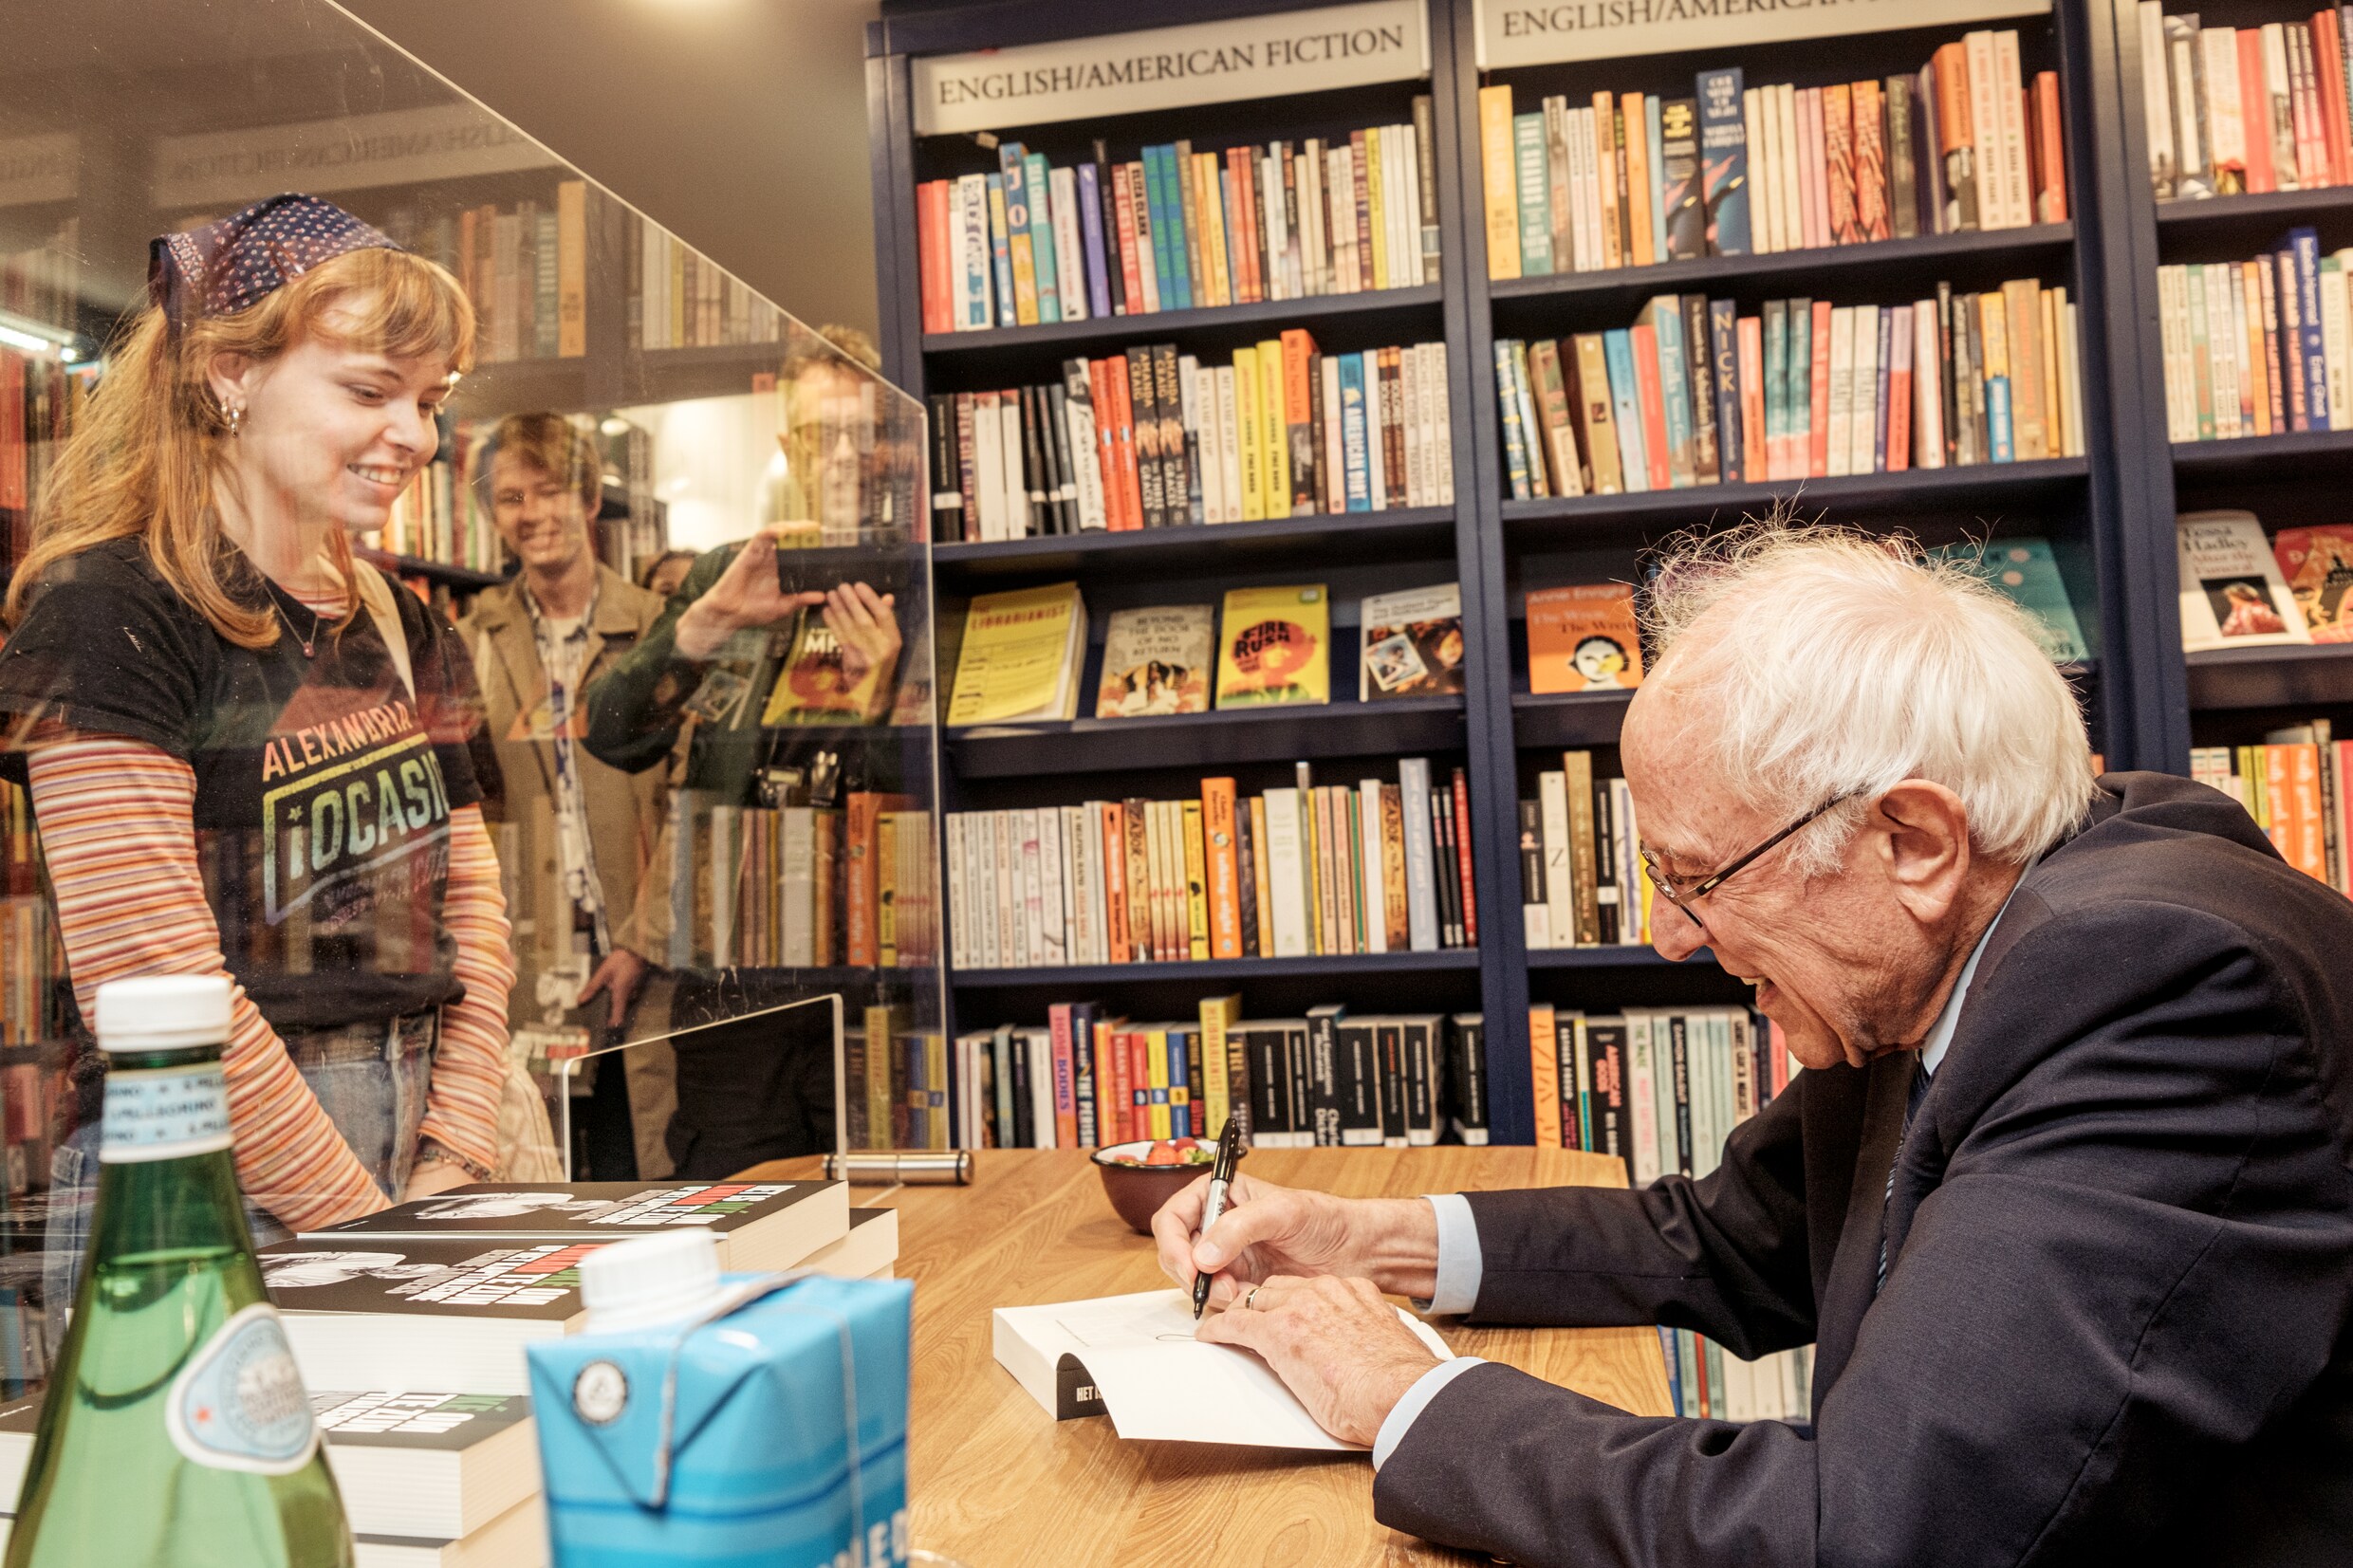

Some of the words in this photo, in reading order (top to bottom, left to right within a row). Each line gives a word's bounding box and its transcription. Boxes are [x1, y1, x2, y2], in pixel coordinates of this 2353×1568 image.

[938, 45, 1254, 104] ENGLISH/AMERICAN
[1266, 25, 1403, 66] FICTION
[1135, 201, 1148, 237] CLARK
[1288, 352, 1300, 373] The
[1418, 348, 1431, 392] RACHEL
[1714, 313, 1733, 393] NICK
[1131, 362, 1142, 400] CRAIG
[1139, 353, 1154, 409] AMANDA
[1157, 360, 1167, 398] CRAIG
[1164, 350, 1178, 406] AMANDA
[1290, 375, 1302, 398] New
[1290, 400, 1304, 420] Life
[1421, 393, 1433, 425] CUSK
[1436, 393, 1448, 425] CUSK
[1343, 407, 1364, 469] AMERICAN
[1410, 446, 1421, 493] TRANSIT
[1423, 440, 1435, 489] TRANSIT
[1438, 438, 1452, 487] OUTLINE
[1139, 464, 1153, 509] GRACES
[1150, 476, 1162, 510] THREE
[1163, 462, 1176, 507] GRACES
[1175, 474, 1186, 507] THREE
[1348, 470, 1367, 501] DIRT
[1234, 633, 1291, 660] RUSH
[1242, 620, 1289, 640] FIRE
[1128, 808, 1141, 856] ZABOR
[1321, 1018, 1332, 1043] Great
[1077, 1076, 1093, 1098] THE
[1595, 1059, 1610, 1093] GODS
[1604, 1044, 1621, 1107] AMERICAN
[1078, 1100, 1095, 1149] PERISH
[1076, 1386, 1093, 1402] HET
